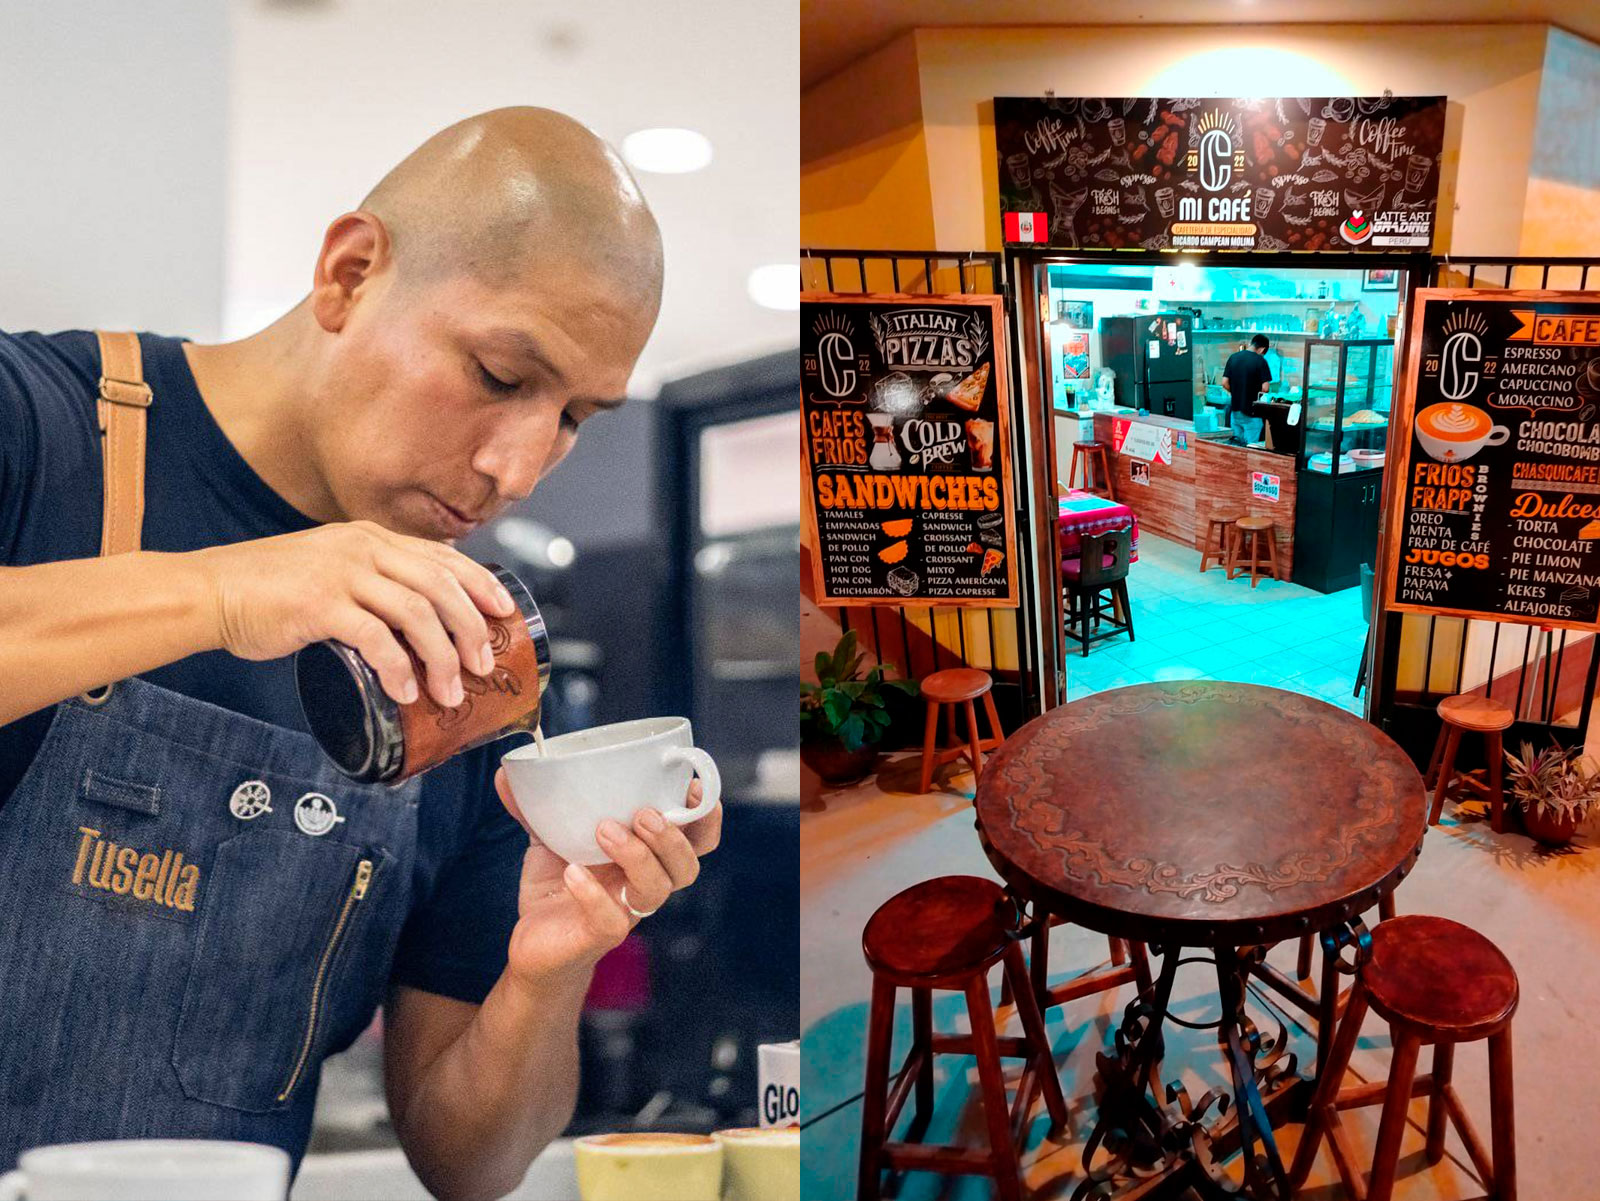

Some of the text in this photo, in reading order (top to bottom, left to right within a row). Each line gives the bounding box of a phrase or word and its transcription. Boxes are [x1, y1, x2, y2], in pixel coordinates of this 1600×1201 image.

[1024, 116, 1062, 155] Coffee
[1360, 116, 1406, 154] Coffee
[1187, 155, 1198, 167] 20
[1234, 155, 1245, 167] 22
[1120, 174, 1157, 188] espresso
[1271, 174, 1309, 188] espresso
[1179, 189, 1252, 222] MI CAFÉ
[1374, 211, 1432, 222] LATTE ART
[1373, 221, 1430, 233] GRADING
[893, 313, 957, 331] ITALIAN
[1537, 319, 1600, 342] CAFE
[887, 336, 972, 366] PIZZAS
[1504, 347, 1561, 360] ESPRESSO
[805, 359, 816, 371] 20
[859, 360, 870, 372] 22
[1425, 360, 1438, 372] 20
[1484, 362, 1497, 374] 22
[1501, 363, 1576, 376] AMERICANO
[1500, 379, 1572, 392] CAPUCCINO
[1498, 394, 1574, 408] MOKACCINO
[809, 410, 865, 438] CAFES
[900, 419, 961, 453] COLD
[1519, 421, 1600, 444] CHOCOLA
[812, 438, 867, 465] FRIOS
[922, 440, 966, 473] BREW
[1517, 439, 1600, 461] CHOCOBOMB
[1414, 463, 1475, 487] FRIOS
[817, 474, 1000, 511] SANDWICHES
[1412, 487, 1472, 511] FRAPP
[1471, 465, 1490, 541] BROWNIES
[824, 511, 864, 519] TAMALES
[922, 512, 964, 520] CAPRESSE
[1410, 512, 1443, 525] OREO
[826, 522, 880, 530] EMPANADAS
[922, 523, 972, 531] SANDWICH
[1409, 525, 1452, 538] MENTA
[1516, 519, 1559, 534] TORTA
[826, 533, 876, 541] SANDWICH
[924, 534, 973, 542] CROISSANT
[828, 544, 870, 552] DE POLLO
[925, 545, 966, 553] DE POLLO
[1408, 537, 1491, 554] FRAP DE CAFÉ
[1513, 536, 1593, 554] CHOCOLATE
[829, 555, 870, 563] PAN CON
[925, 556, 974, 564] CROISSANT
[1405, 548, 1490, 570] JUGOS
[1511, 552, 1582, 569] PIE LIMON
[831, 566, 871, 574] HOT DOG
[927, 566, 955, 574] MIXTO
[1405, 565, 1442, 578] FRESA
[832, 576, 850, 584] PAN
[928, 577, 953, 585] PIZZA
[1403, 577, 1449, 591] PAPAYA
[1509, 568, 1600, 588] PIE MANZANA
[929, 588, 996, 596] PIZZA CAPRESSE
[1402, 588, 1433, 602] PIÑA
[1507, 584, 1546, 598] KEKES
[1503, 600, 1572, 617] ALFAJORES
[72, 826, 200, 912] Tusella
[764, 1083, 799, 1125] GLO
